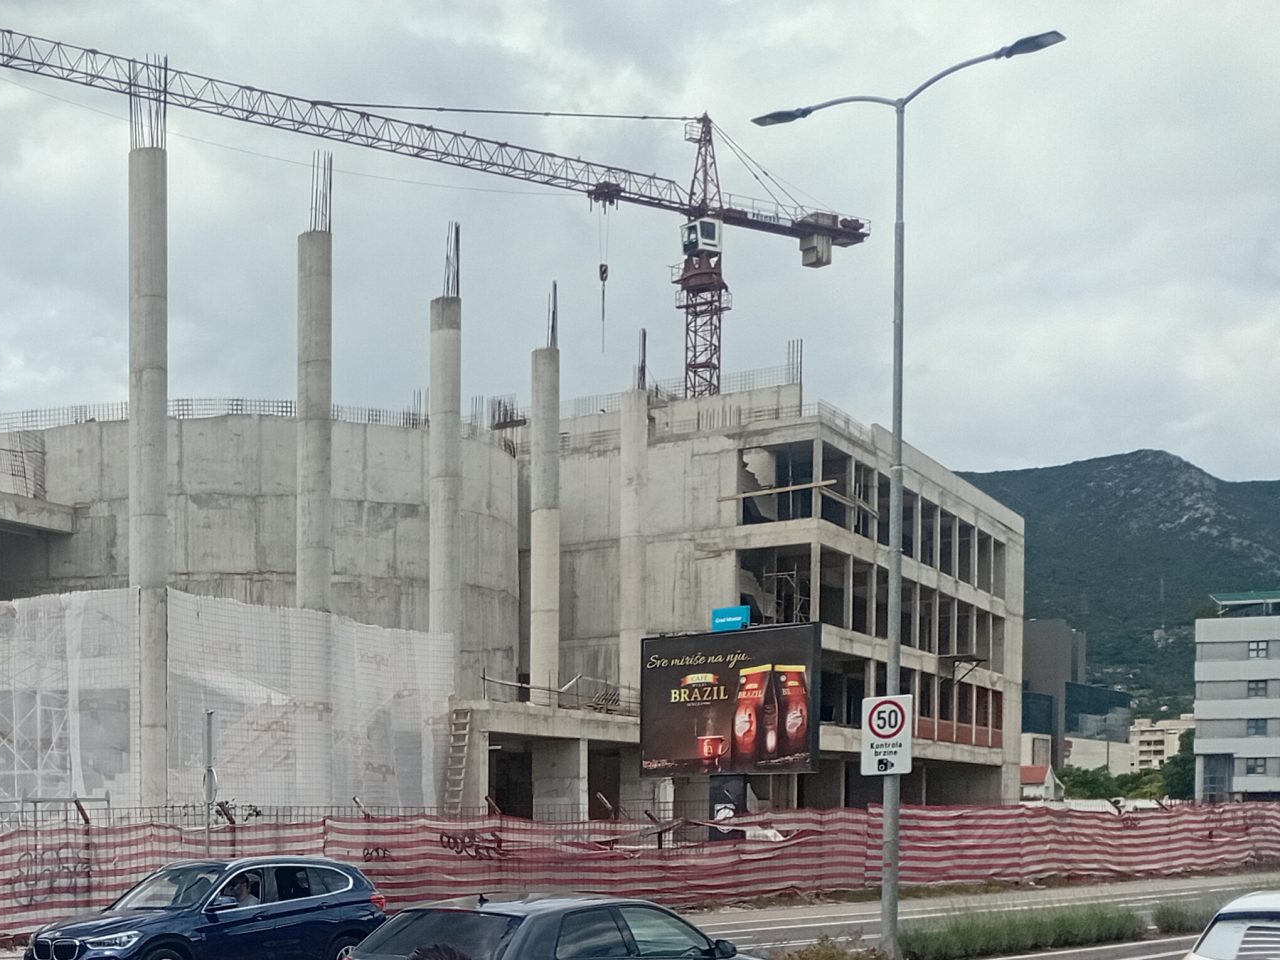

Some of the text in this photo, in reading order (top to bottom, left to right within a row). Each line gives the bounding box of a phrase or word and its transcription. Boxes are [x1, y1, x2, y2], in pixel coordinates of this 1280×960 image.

[646, 654, 669, 669] Sve
[707, 654, 725, 664] na
[670, 685, 729, 703] BRAZIL
[876, 709, 898, 730] 50
[870, 741, 903, 750] Kontrola
